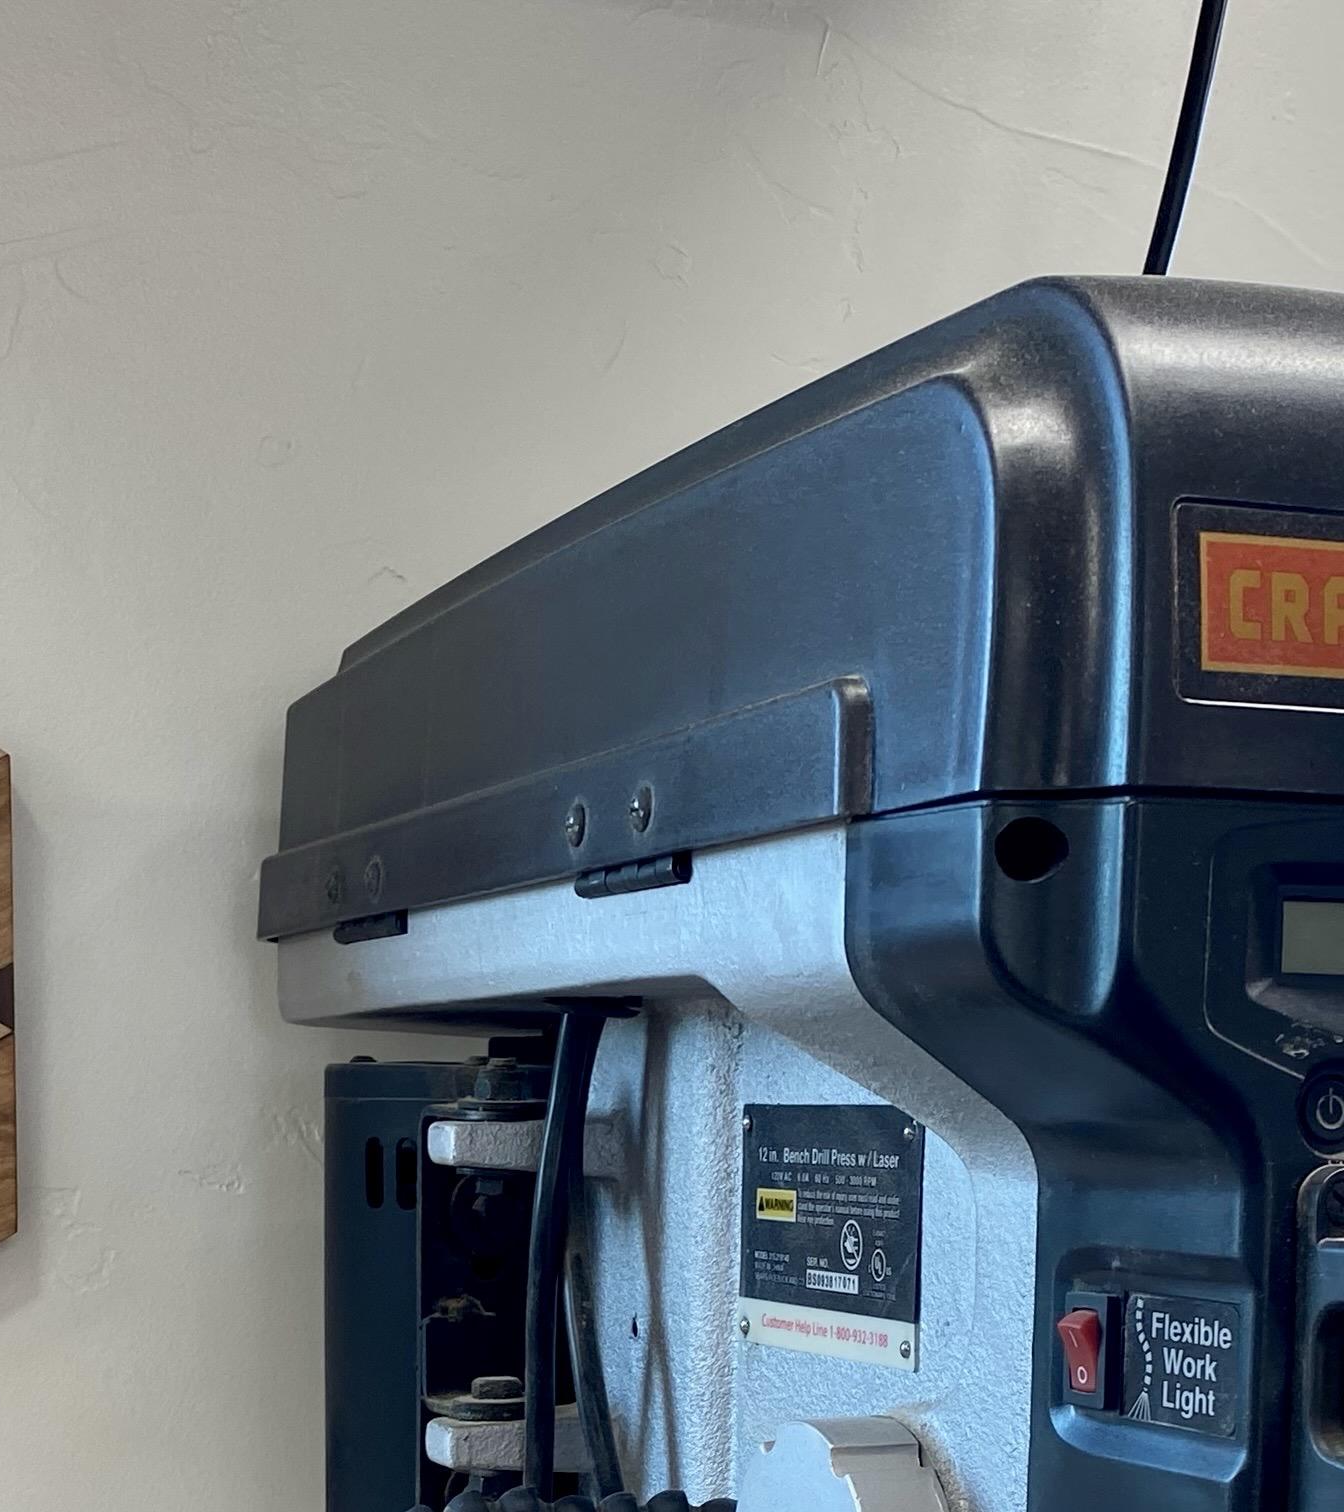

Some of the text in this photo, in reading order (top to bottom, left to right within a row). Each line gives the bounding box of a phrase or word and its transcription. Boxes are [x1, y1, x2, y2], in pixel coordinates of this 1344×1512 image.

[758, 1147, 768, 1162] 12
[783, 1147, 810, 1164] Bench
[811, 1148, 830, 1166] Drill
[831, 1149, 856, 1167] Press
[765, 1198, 794, 1212] WARNING
[761, 1313, 794, 1331] Customer
[795, 1320, 811, 1337] Help
[812, 1322, 828, 1338] Line
[1151, 1311, 1232, 1349] Flexible
[1162, 1347, 1217, 1382] Work
[1162, 1381, 1216, 1419] Light
